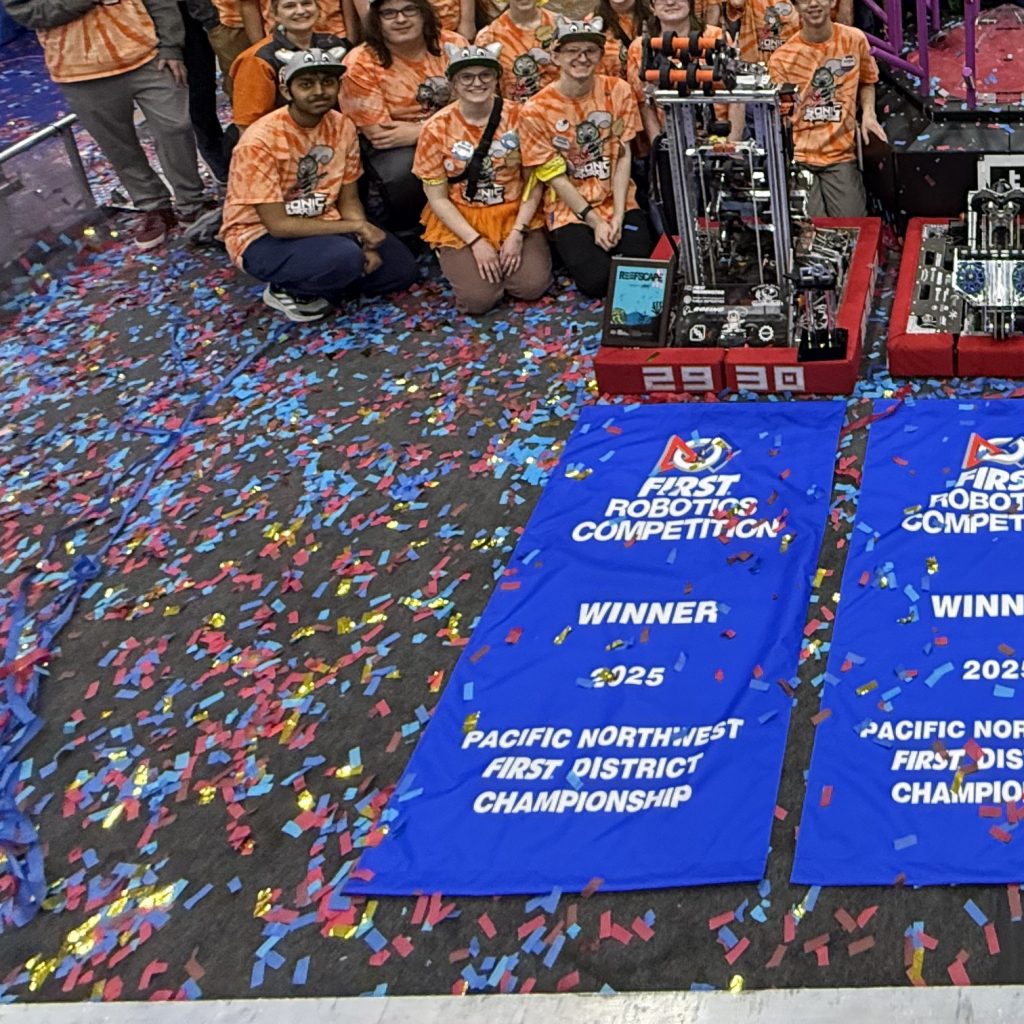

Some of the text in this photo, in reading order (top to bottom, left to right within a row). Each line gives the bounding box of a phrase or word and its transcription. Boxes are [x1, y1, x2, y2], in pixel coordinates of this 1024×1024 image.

[637, 474, 741, 498] FIRST
[578, 601, 718, 625] WINNER
[590, 665, 665, 688] 2025
[461, 727, 572, 749] PACIFIC
[861, 721, 965, 739] PACIFIC
[482, 753, 704, 780] FIRST DISTRICT
[891, 749, 966, 770] FIRST
[473, 784, 692, 813] CHAMPIONSHIP
